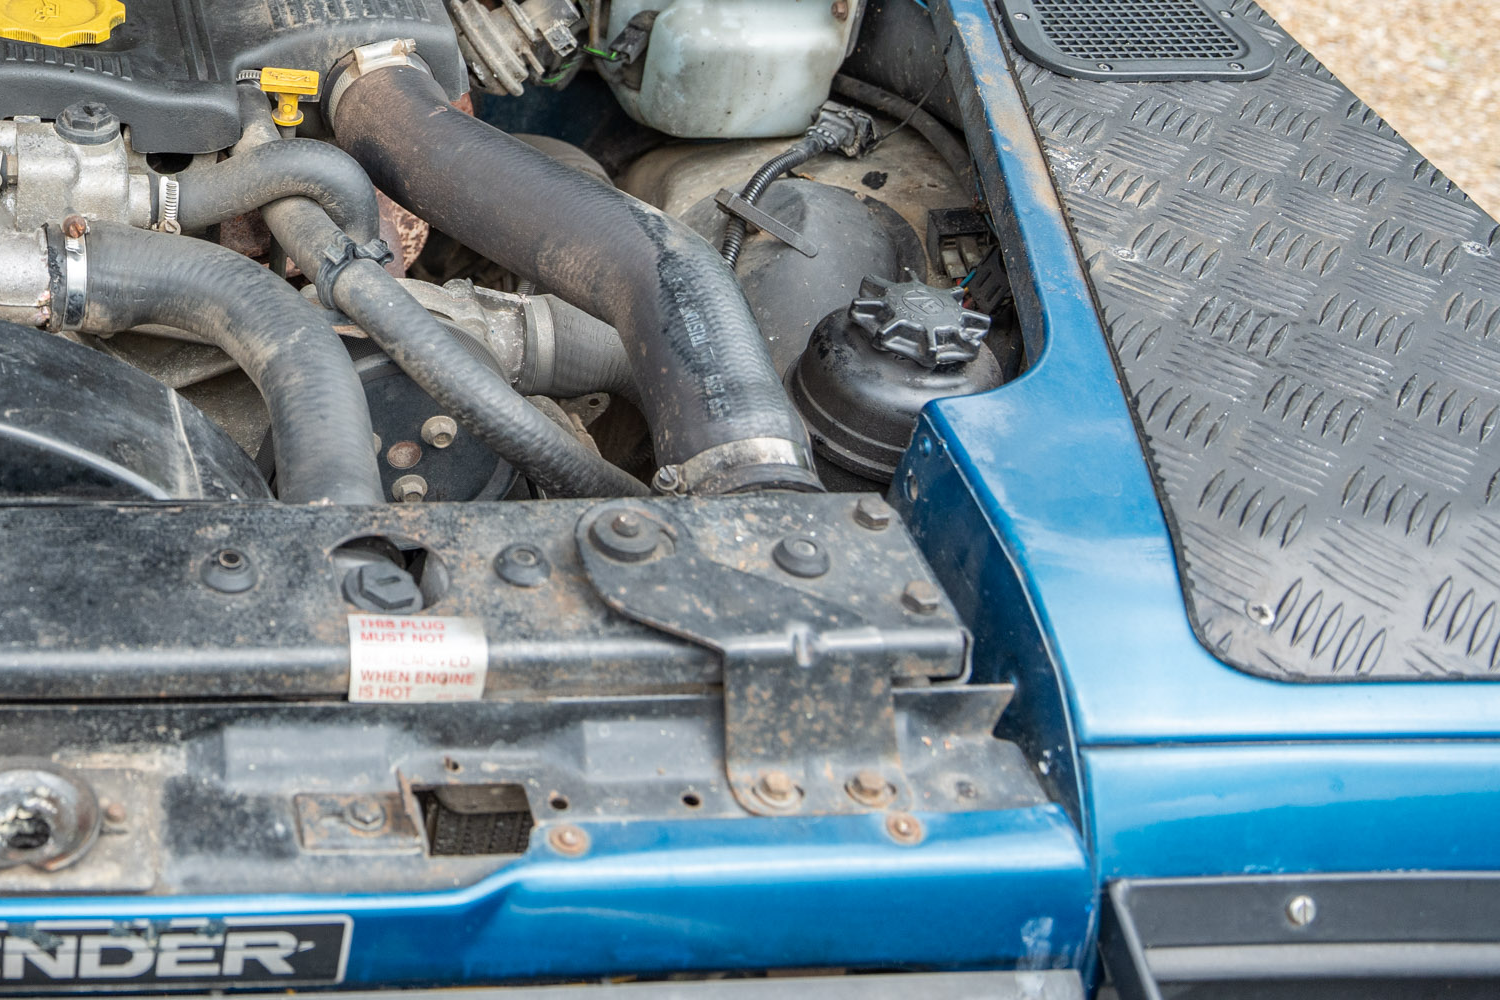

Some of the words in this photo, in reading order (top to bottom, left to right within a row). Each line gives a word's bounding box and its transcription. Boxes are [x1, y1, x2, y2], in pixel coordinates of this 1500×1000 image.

[359, 619, 396, 629] THIS
[400, 620, 446, 631] PLUG
[360, 632, 405, 642] MUST
[412, 633, 445, 643] NOT
[360, 669, 410, 683] WHEN
[415, 671, 476, 685] ENGINE
[358, 685, 374, 697] IS
[378, 686, 413, 699] HOT
